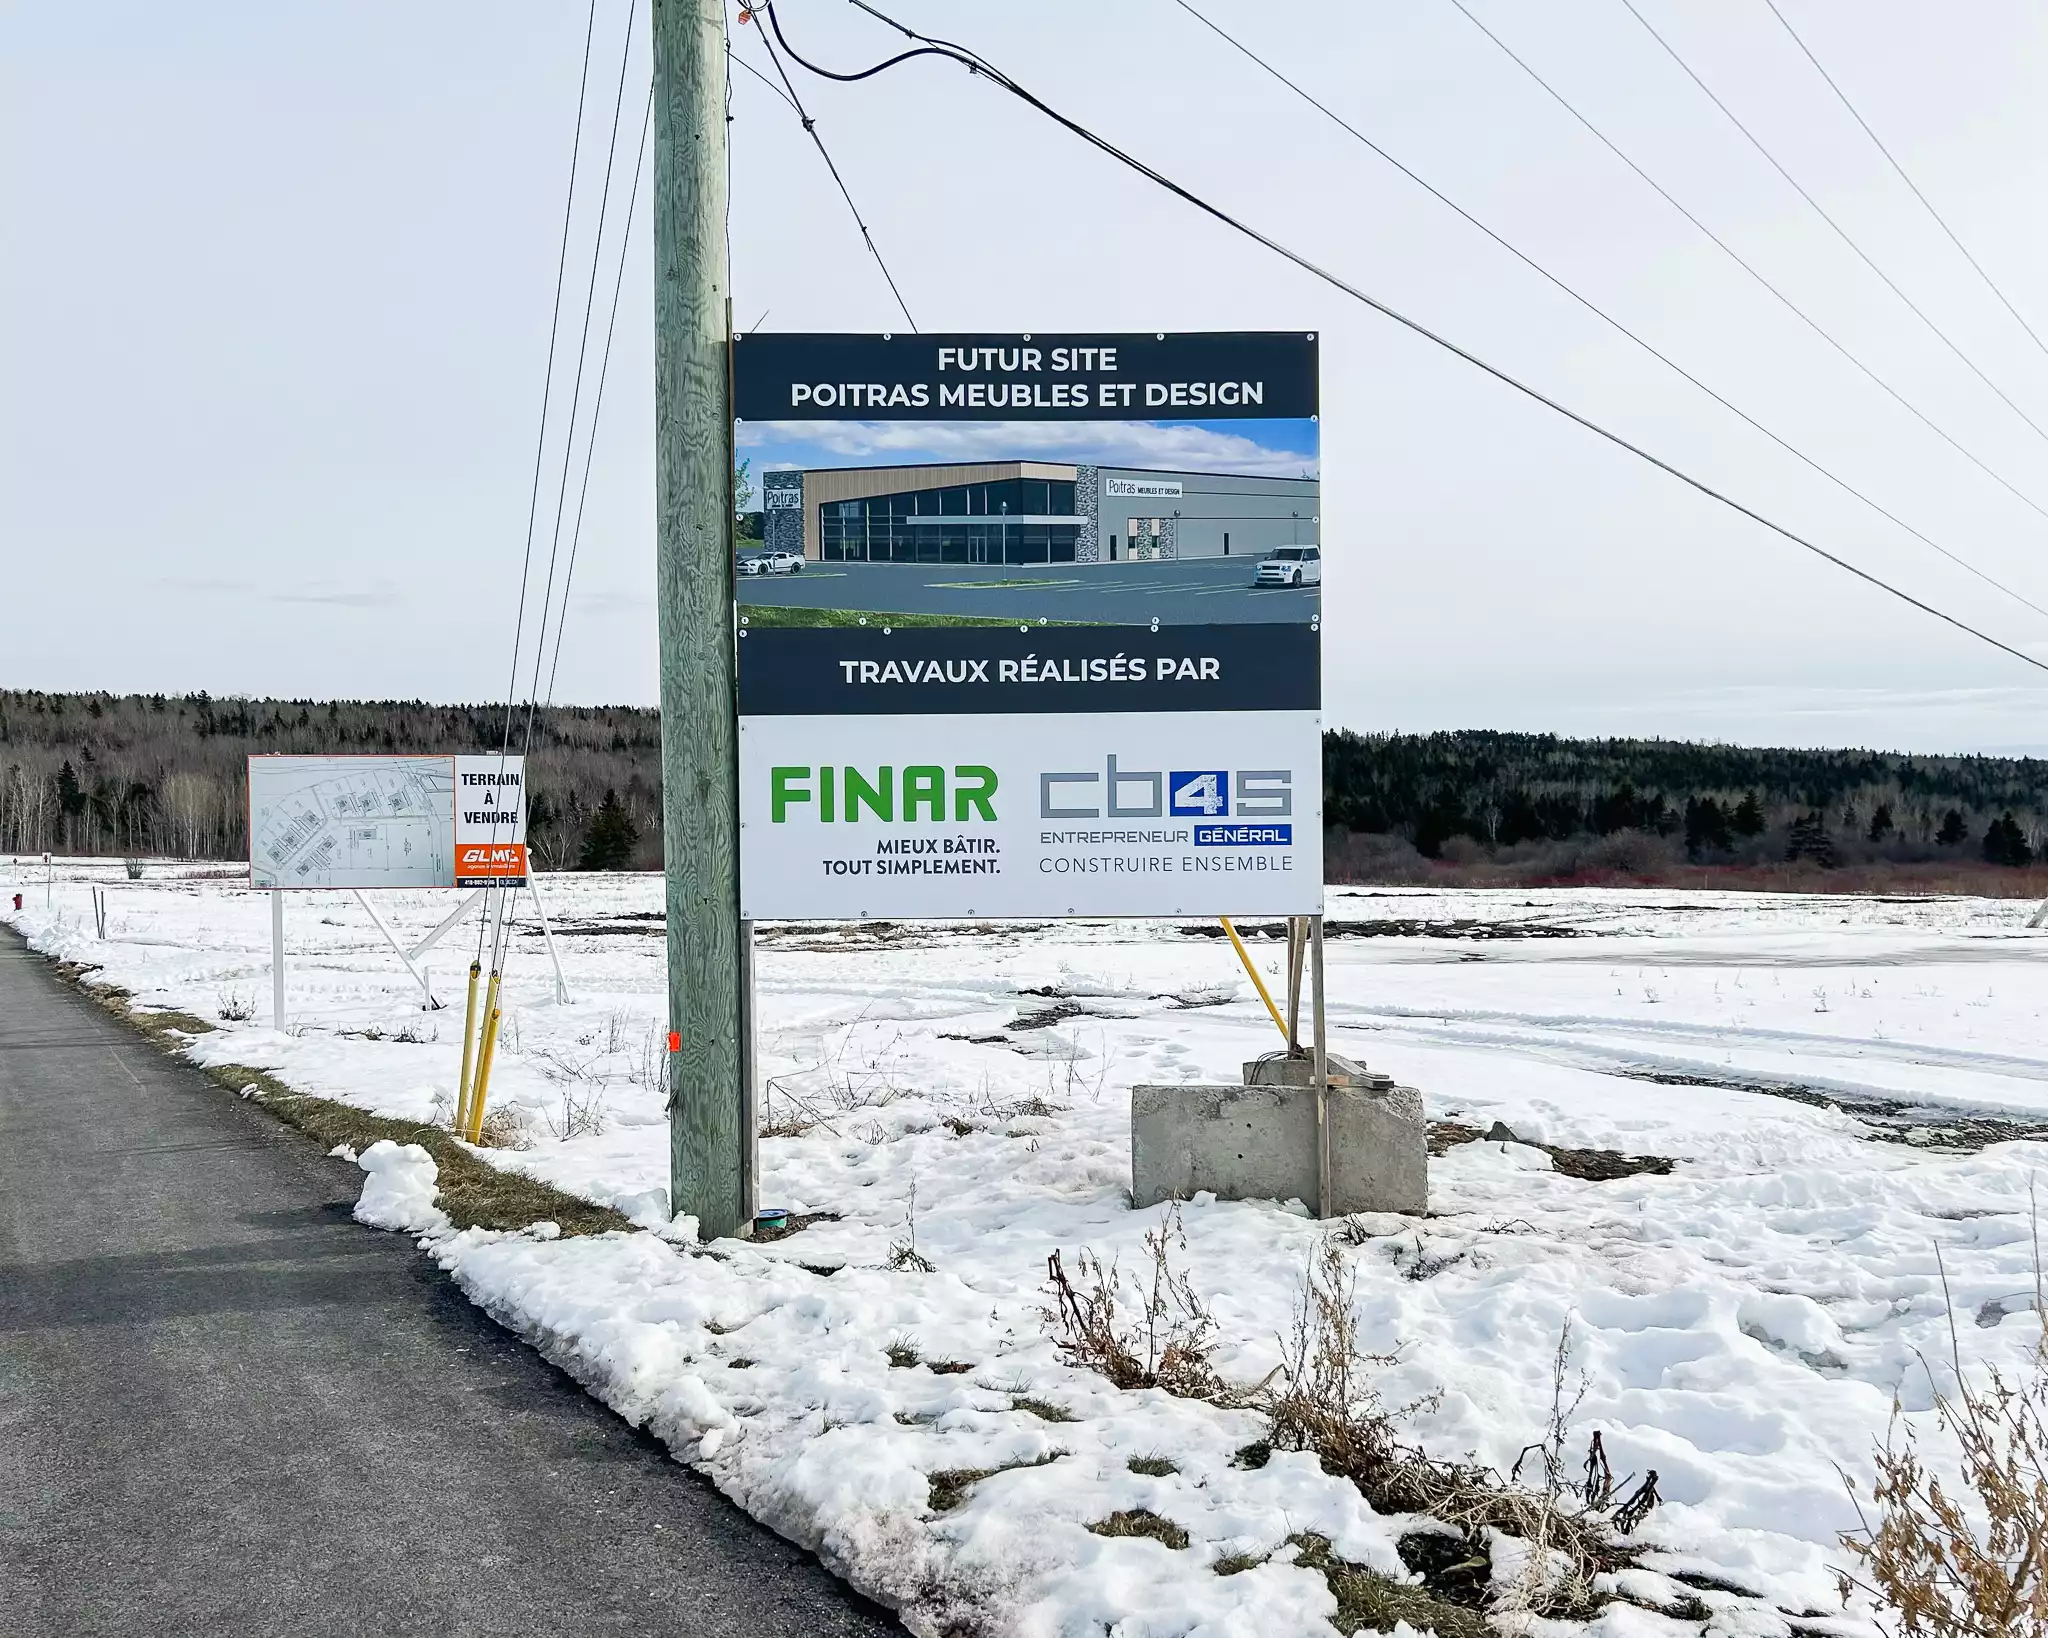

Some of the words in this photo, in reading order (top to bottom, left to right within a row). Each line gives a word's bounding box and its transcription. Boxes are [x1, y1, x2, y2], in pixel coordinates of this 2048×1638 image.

[937, 347, 1042, 372] FUTUR
[1051, 346, 1117, 371] SITE
[791, 383, 929, 408] POITRAS
[939, 383, 1089, 408] MEUBLES
[1099, 383, 1136, 407] ET
[1145, 381, 1264, 406] DESIGN
[1109, 479, 1136, 494] Poitras
[767, 491, 799, 504] Poitras
[839, 659, 989, 684] TRAVAUX
[998, 652, 1147, 683] RÉALISÉS
[1156, 657, 1220, 681] PAR
[461, 773, 519, 785] TERRAIN
[484, 790, 493, 804] À
[771, 765, 999, 823] FINAR
[464, 812, 518, 824] VENDRE
[1040, 829, 1188, 844] ENTREPRENEUR
[1198, 825, 1289, 843] GÉNÉRAL
[877, 838, 937, 855] MIEUX
[943, 834, 1001, 854] BÂTIR.
[462, 849, 519, 862] GLMC
[1039, 856, 1173, 873] CONSTRUIRE
[1182, 855, 1292, 872] ENSEMBLE
[822, 860, 873, 875] TOUT
[876, 858, 1001, 875] SIMPLEMENT.
